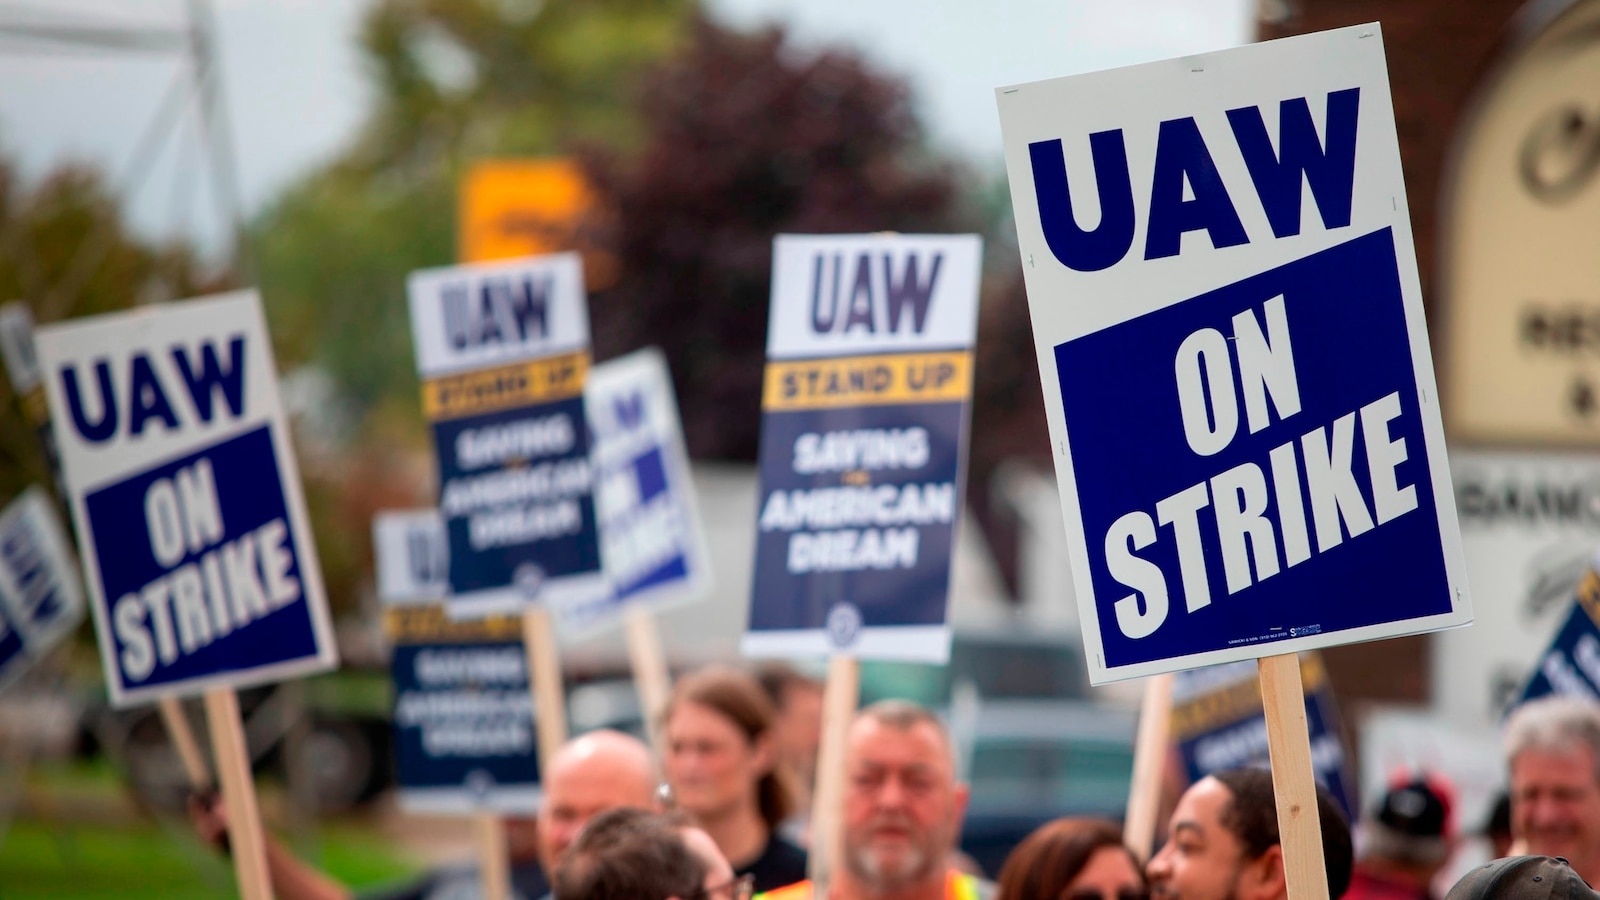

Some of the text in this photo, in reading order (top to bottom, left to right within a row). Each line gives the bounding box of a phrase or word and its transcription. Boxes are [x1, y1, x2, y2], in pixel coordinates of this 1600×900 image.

[1028, 87, 1360, 272] UAW
[439, 272, 556, 351] UAW
[810, 249, 944, 336] UAW
[59, 334, 247, 448] UAW
[782, 364, 957, 400] STAND UP
[1175, 293, 1301, 456] ON
[793, 426, 930, 475] SAVING
[143, 457, 224, 570] ON
[760, 482, 954, 532] AMERICAN
[788, 526, 919, 575] DREAM
[1104, 391, 1418, 639] STRIKE
[111, 517, 301, 684] STRIKE
